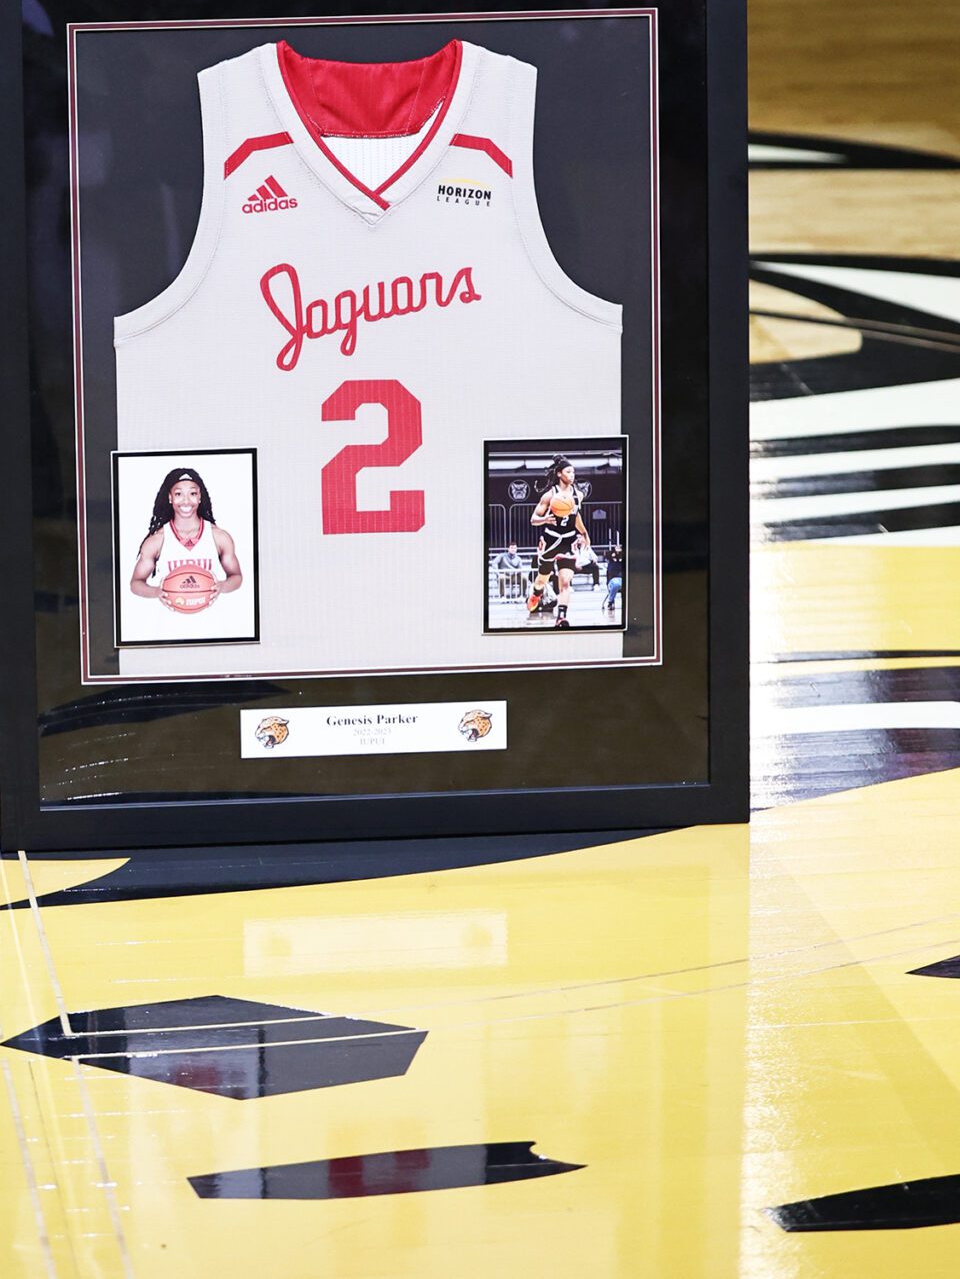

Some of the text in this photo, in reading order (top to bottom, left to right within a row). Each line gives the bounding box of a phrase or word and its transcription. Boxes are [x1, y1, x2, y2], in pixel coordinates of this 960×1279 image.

[438, 185, 492, 200] HORIZON
[242, 196, 298, 214] adidas
[437, 197, 491, 207] LEAGUE
[260, 263, 482, 372] Jaguars
[321, 379, 426, 535] 2
[326, 713, 419, 726] Genesis Parker
[360, 737, 386, 745] IUPUI
